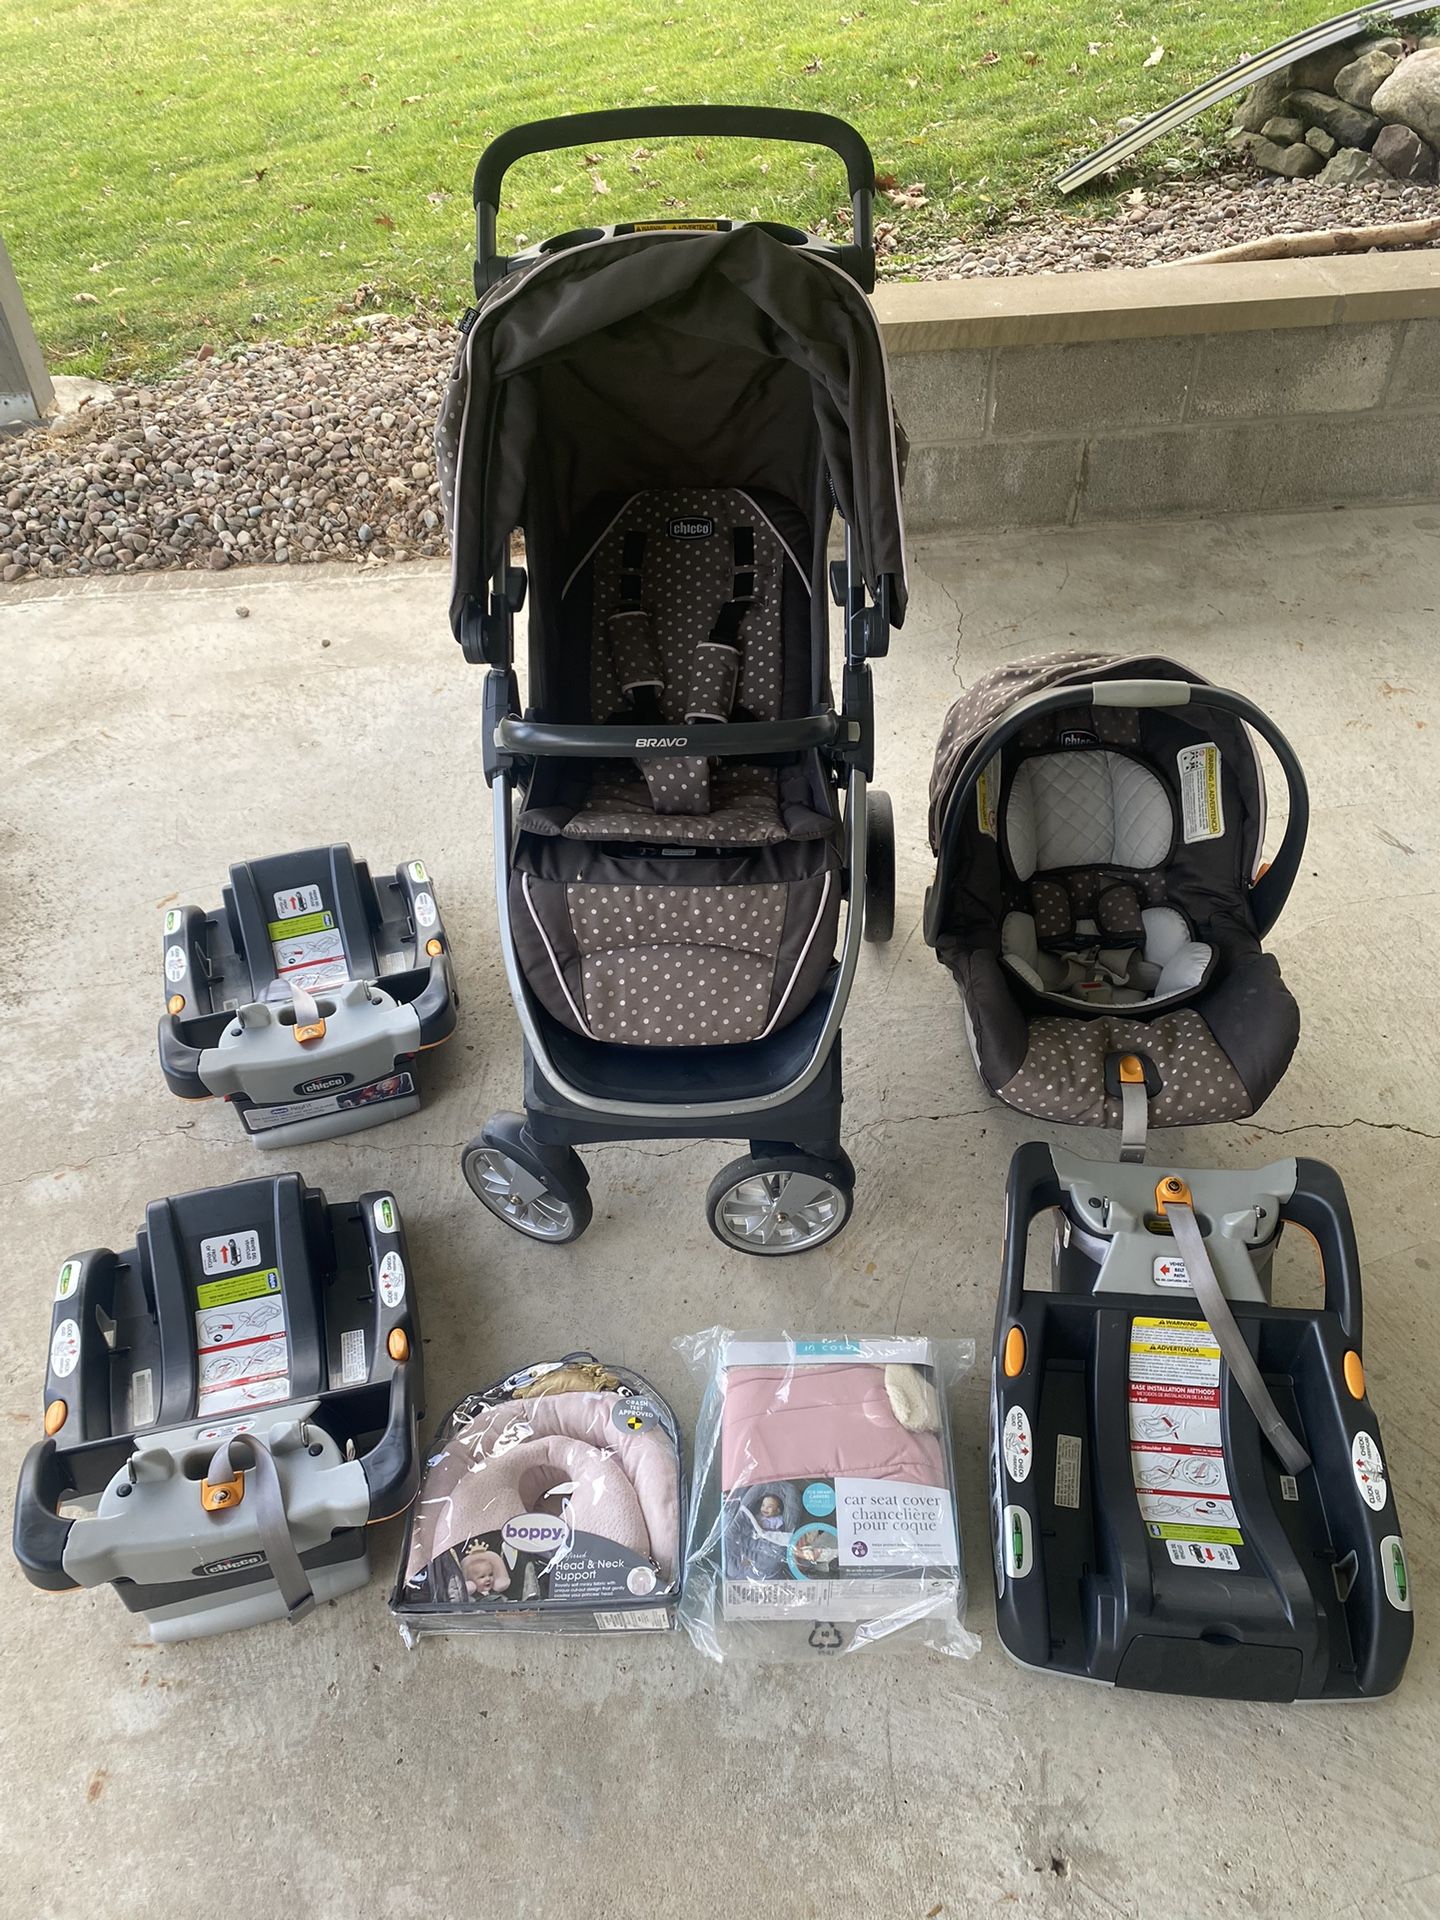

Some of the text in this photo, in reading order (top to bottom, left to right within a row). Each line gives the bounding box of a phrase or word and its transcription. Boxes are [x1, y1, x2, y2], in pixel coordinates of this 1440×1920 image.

[674, 521, 709, 534] chicco
[635, 737, 688, 748] BRAVO
[1209, 791, 1218, 833] ADVERTENCIA
[306, 1077, 342, 1093] chicco
[1166, 1319, 1198, 1327] WARNING
[1157, 1344, 1199, 1353] ADVERTENCIA
[1147, 1385, 1186, 1393] INSTALLATION
[619, 1409, 653, 1418] APPROVED
[844, 1495, 940, 1506] car seat cover
[852, 1507, 936, 1520] chancelière
[853, 1521, 937, 1535] pour coque
[209, 1557, 258, 1573] chicco
[556, 1559, 625, 1570] Head & Neck
[555, 1570, 596, 1582] Support
